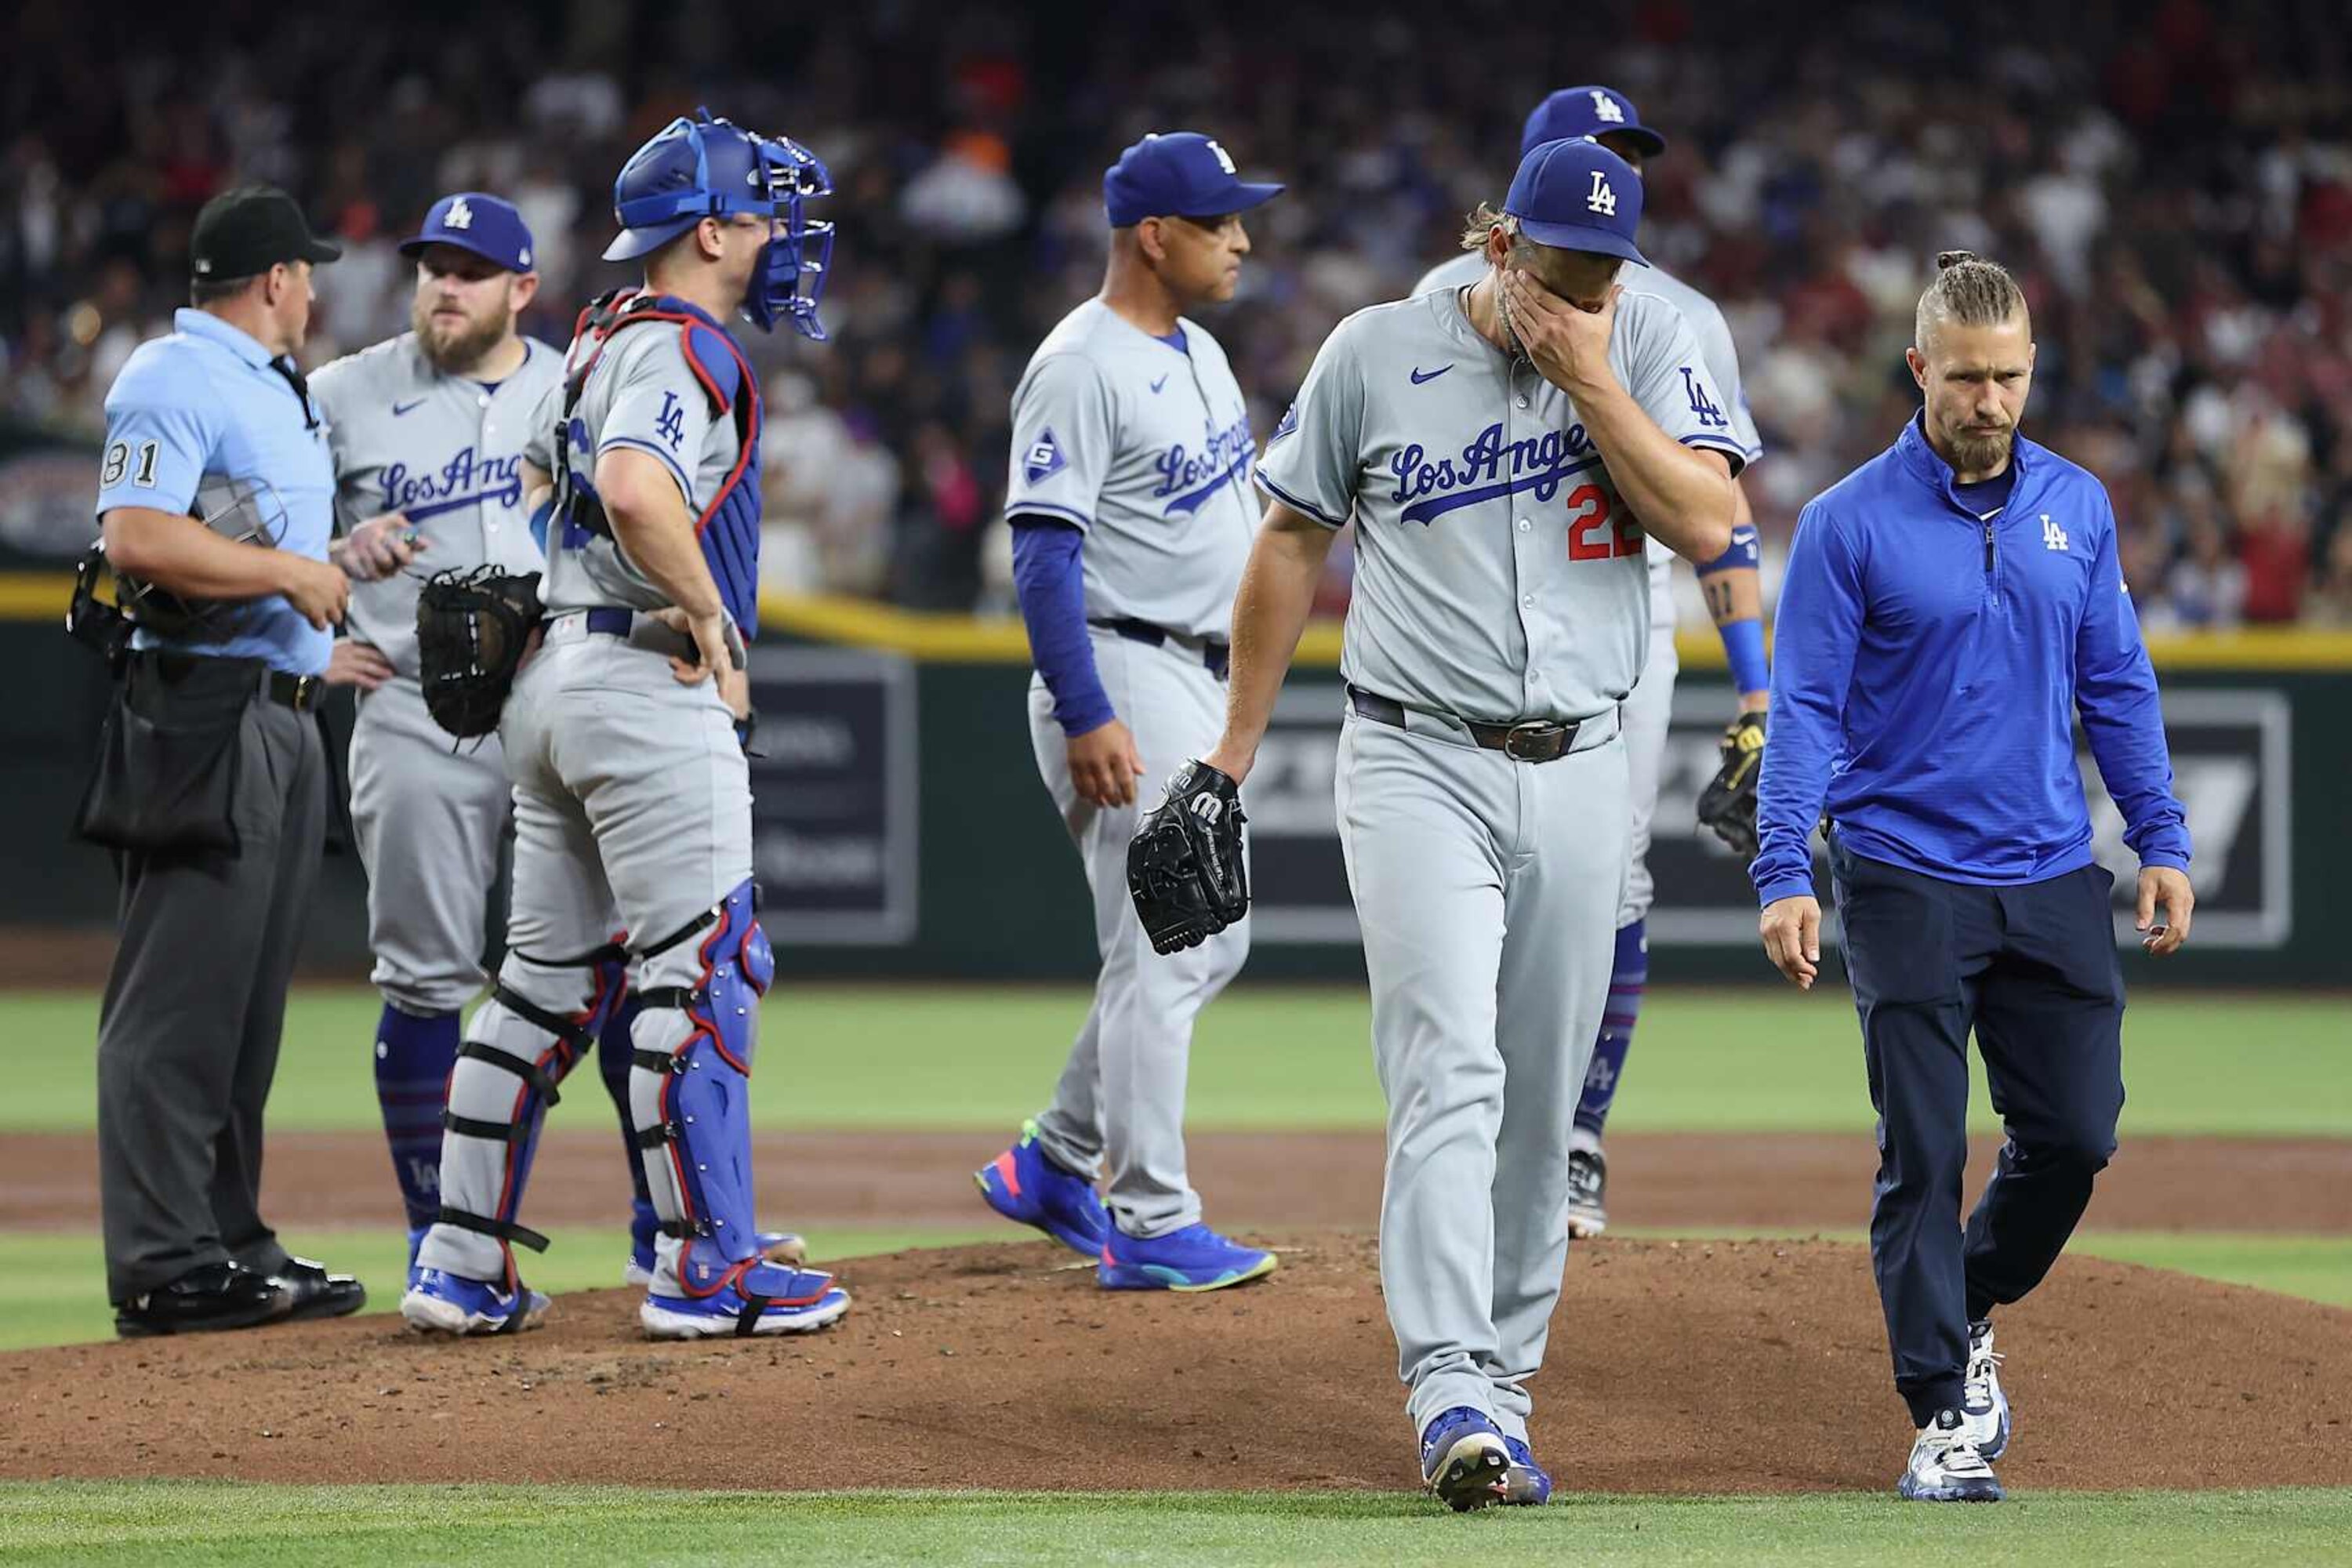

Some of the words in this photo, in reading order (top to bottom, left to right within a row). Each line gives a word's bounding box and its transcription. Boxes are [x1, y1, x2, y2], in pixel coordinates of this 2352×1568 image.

[1590, 91, 1624, 123] LA
[1587, 171, 1617, 216] LA
[655, 390, 684, 452] LA
[1679, 368, 1728, 426] LA
[100, 439, 159, 490] 81
[379, 463, 435, 512] Los
[1154, 444, 1208, 498] Los
[1391, 444, 1456, 503] Los
[2039, 514, 2069, 550] LA
